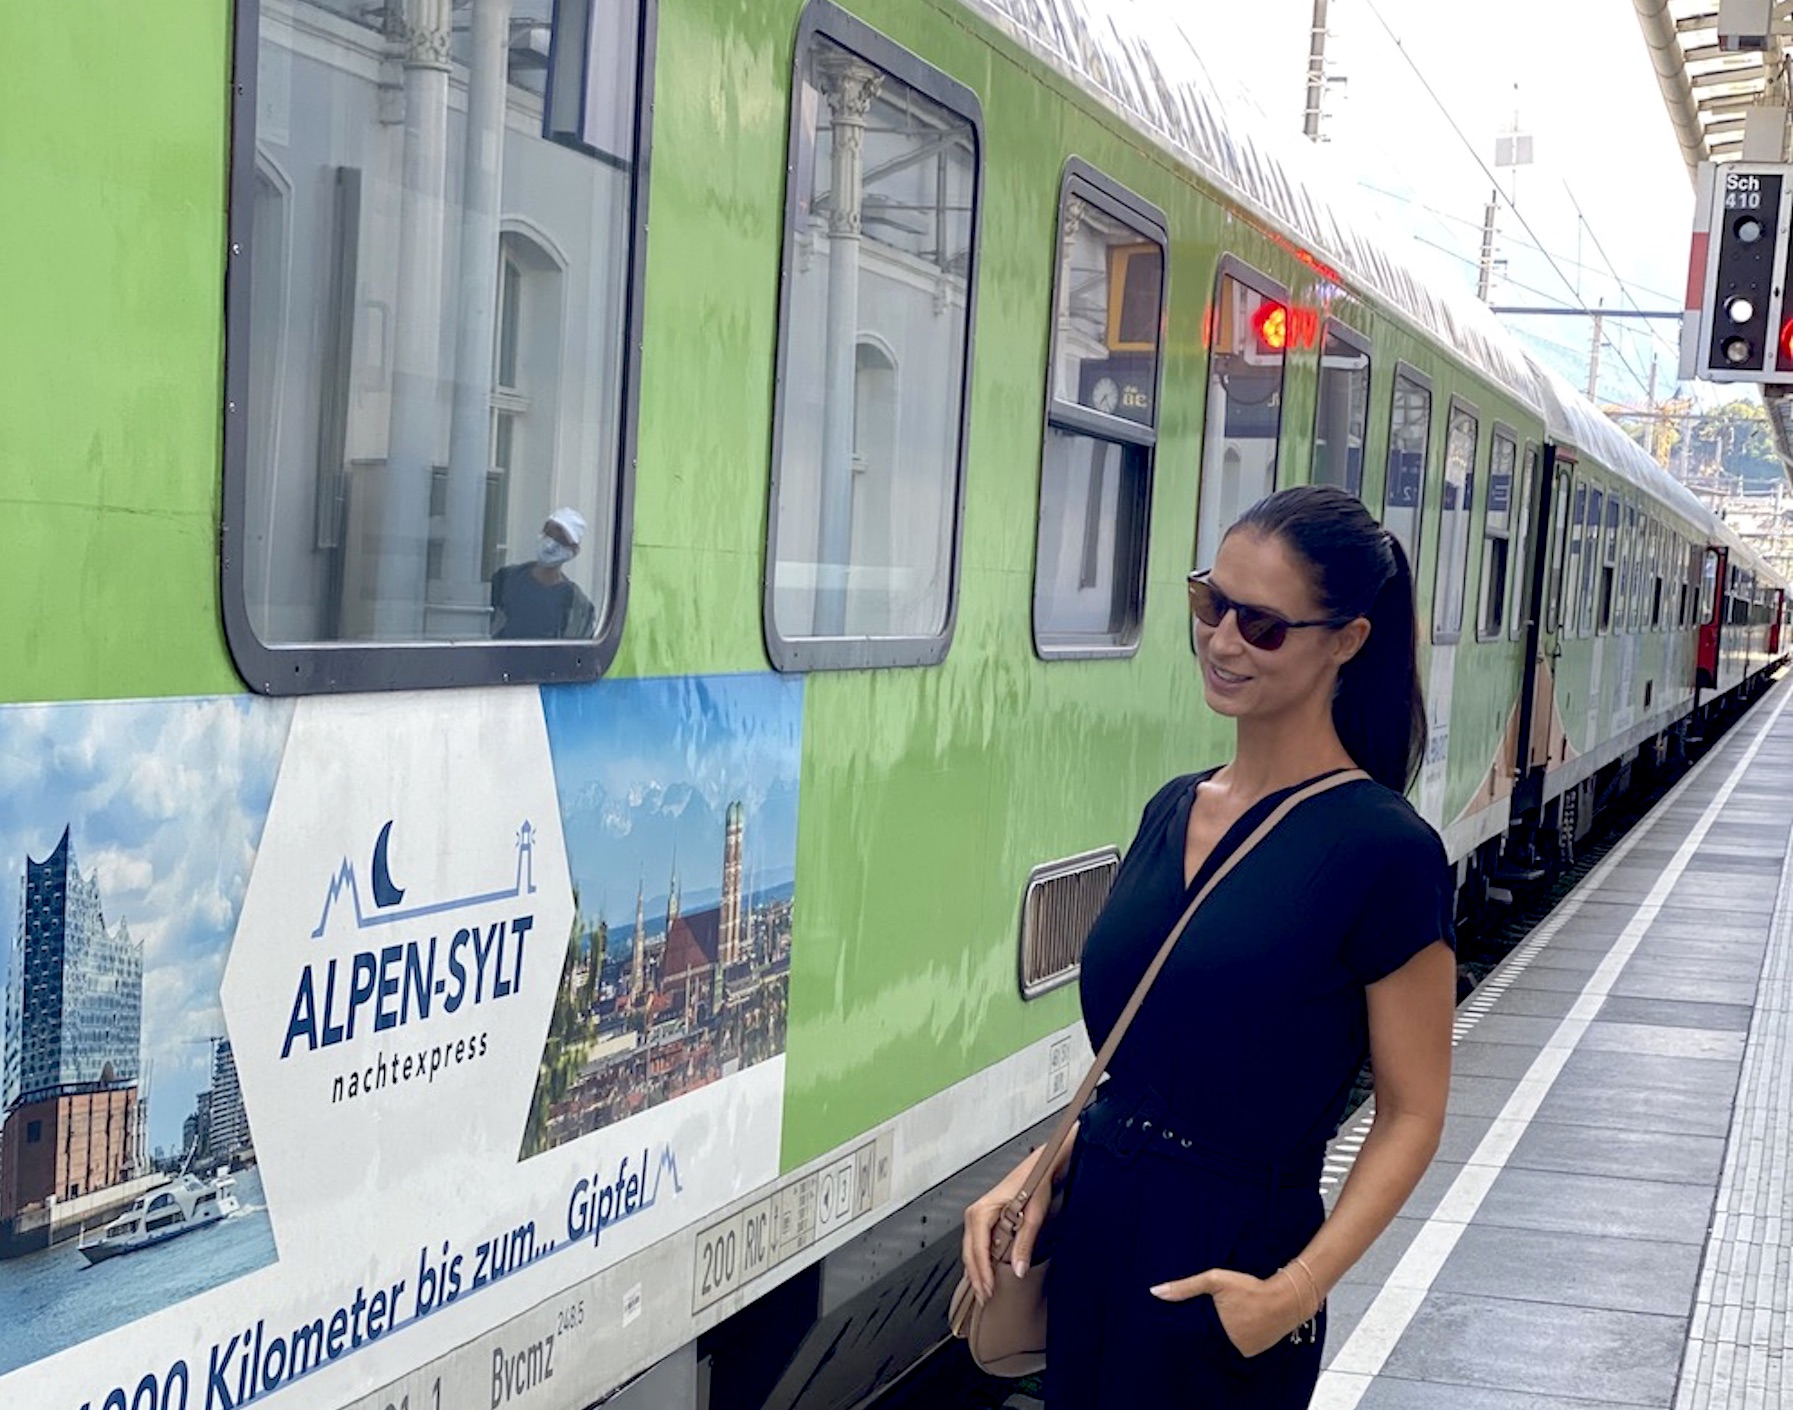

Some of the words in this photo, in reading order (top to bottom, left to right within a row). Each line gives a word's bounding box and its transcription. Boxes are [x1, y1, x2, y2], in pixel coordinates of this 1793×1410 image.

[1725, 193, 1761, 209] 410
[1726, 174, 1760, 191] Sch
[279, 915, 534, 1060] ALPEN-SYLT
[331, 1032, 488, 1104] nachtexpress
[204, 1279, 406, 1410] Kilometer
[414, 1239, 464, 1318] bis
[471, 1220, 556, 1291] zum...
[567, 1148, 649, 1248] Gipfel
[702, 1229, 736, 1297] 200
[744, 1212, 768, 1271] RIC
[491, 1335, 555, 1410] Bvcmz
